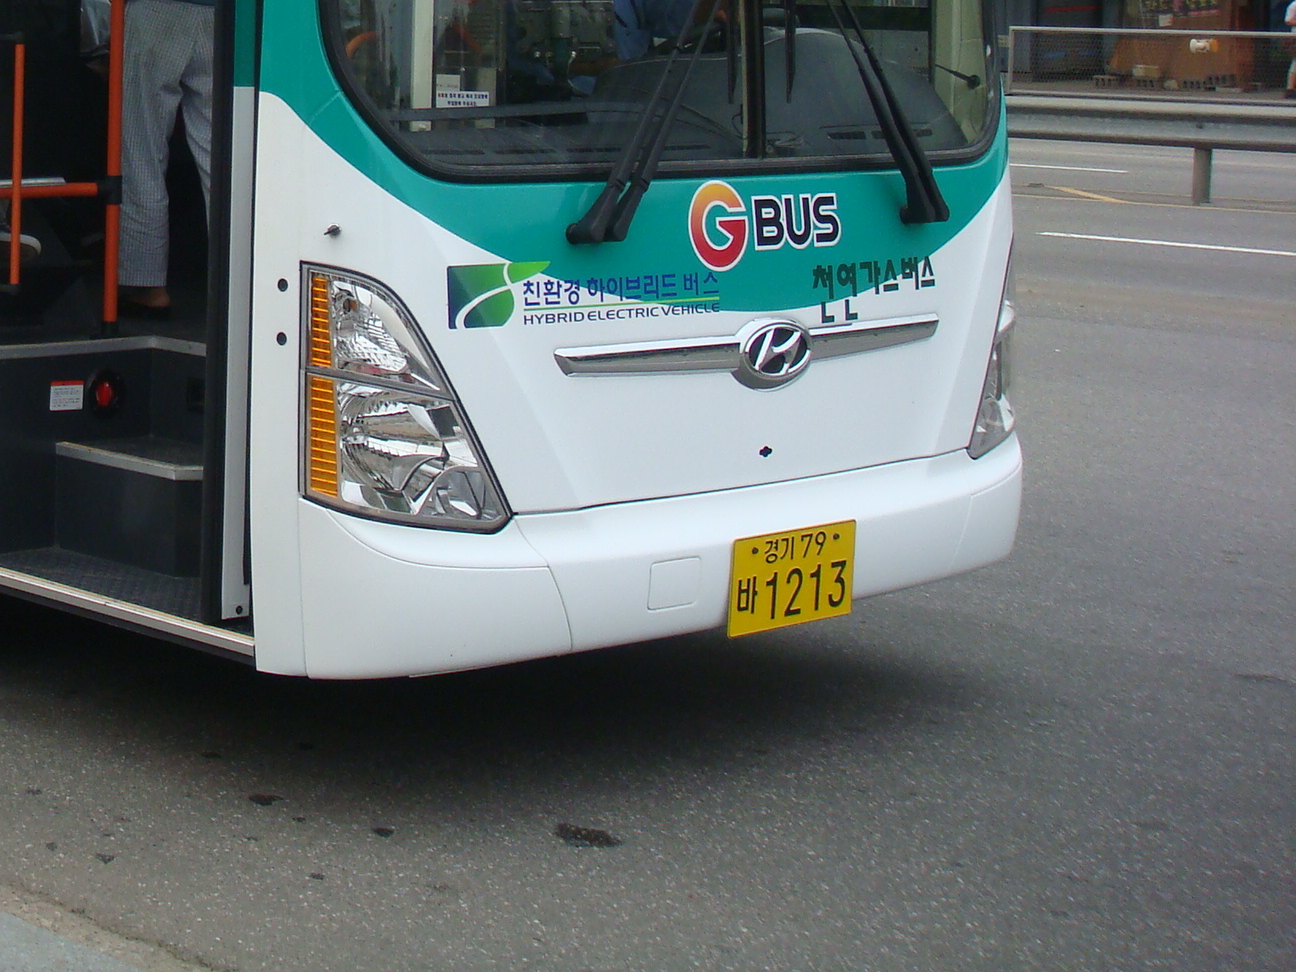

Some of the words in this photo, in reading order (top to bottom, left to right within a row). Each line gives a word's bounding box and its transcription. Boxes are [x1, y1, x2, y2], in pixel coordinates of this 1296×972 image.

[523, 279, 580, 307] 친환경
[587, 273, 677, 303] 하이브리드
[683, 271, 719, 296] 버스
[812, 255, 935, 323] 천연가스버스
[523, 311, 585, 326] HYBRID
[587, 306, 659, 322] ELECTRIC
[660, 302, 720, 316] VEHICLE
[764, 536, 794, 564] 경기
[800, 531, 826, 558] 79
[737, 575, 758, 615] 바
[765, 559, 847, 620] 1213
